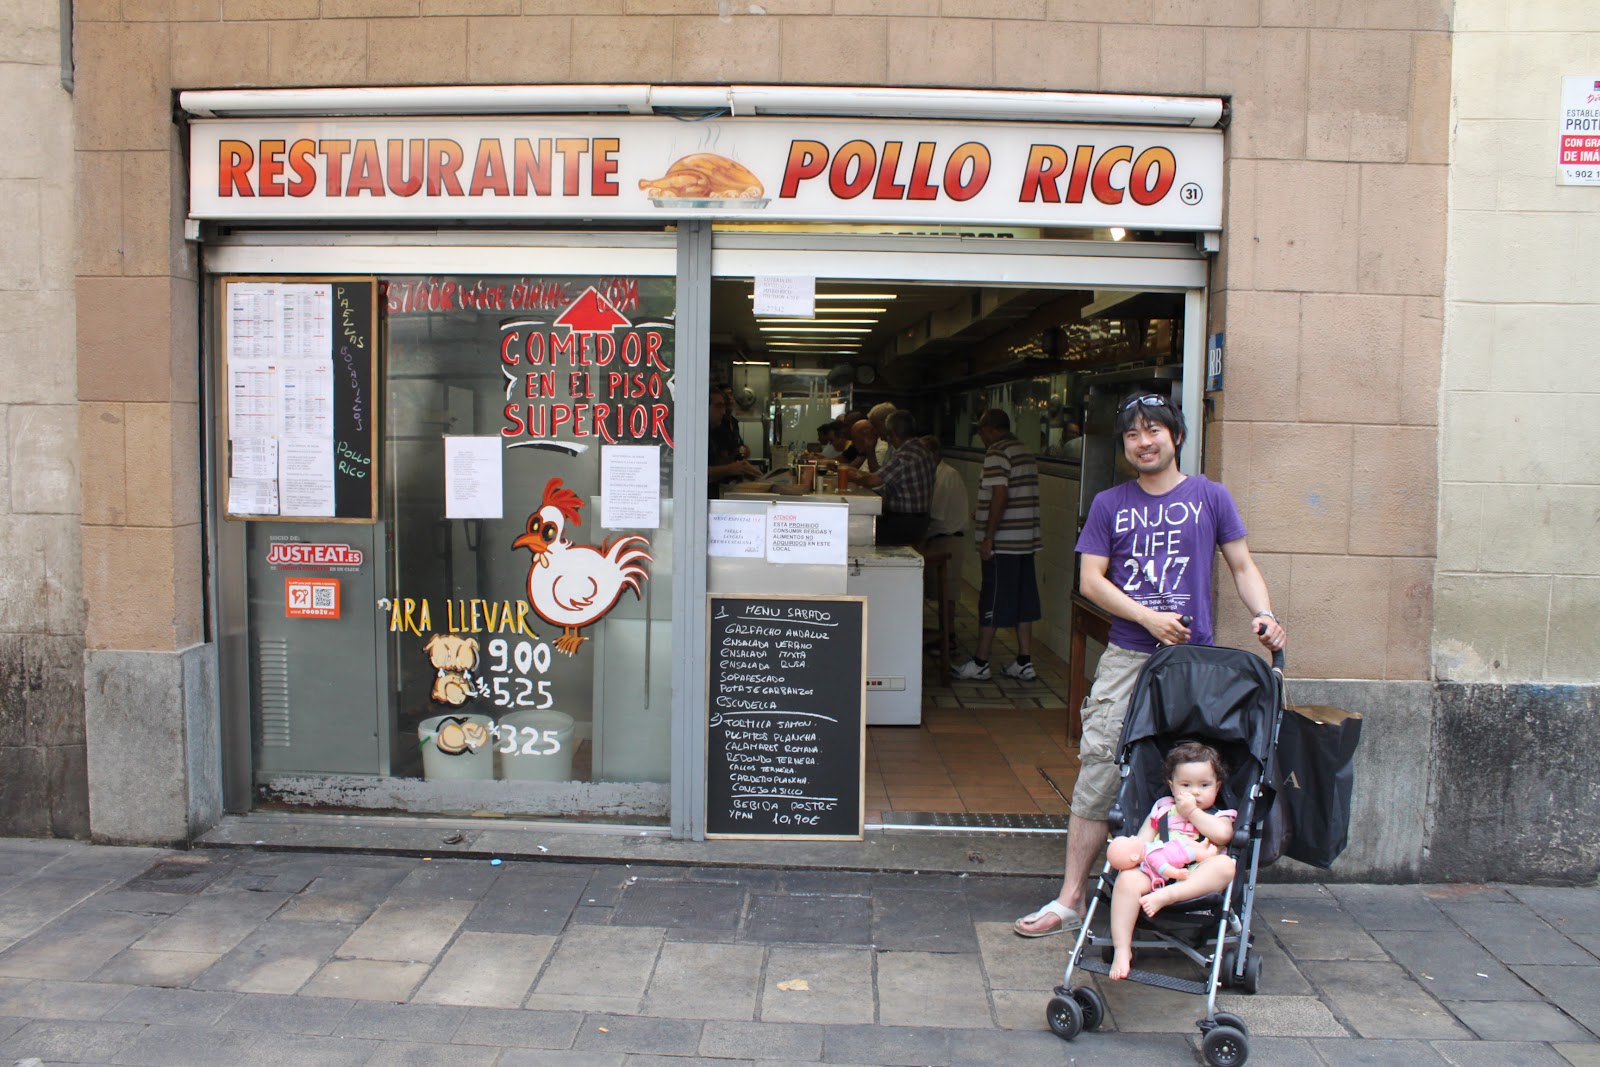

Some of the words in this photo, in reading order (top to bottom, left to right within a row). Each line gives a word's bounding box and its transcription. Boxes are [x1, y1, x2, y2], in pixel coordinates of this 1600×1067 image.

[1566, 109, 1600, 117] ESTABLE
[1564, 138, 1582, 147] CON
[1563, 150, 1577, 161] DE
[218, 137, 620, 198] RESTAURANTE
[778, 139, 991, 201] POLLO
[1018, 143, 1177, 206] RICO
[1185, 188, 1198, 200] 31
[1575, 170, 1592, 178] 902
[337, 287, 364, 348] PAELLAS
[501, 331, 670, 371] COMEDOR
[340, 346, 363, 431] BOCADILLOS
[526, 372, 555, 399] EN
[570, 372, 595, 399] EL
[609, 372, 663, 399] PISO
[501, 403, 675, 448] SUPERIOR
[337, 441, 371, 465] POLLO
[338, 461, 366, 478] RICO
[1115, 502, 1203, 533] ENJOY
[1131, 529, 1182, 557] LIFE
[270, 546, 312, 562] JUST
[1123, 556, 1190, 594] 24/7
[447, 599, 540, 640] LLEVAR
[745, 605, 781, 617] MENU
[787, 607, 831, 621] SABADO
[785, 628, 830, 640] ANDALUZ
[722, 637, 769, 649] ENSALADA
[775, 640, 813, 650] VERANO
[720, 648, 767, 659] ENSALADA
[778, 650, 807, 659] MIXTA
[719, 660, 770, 671] ENSALADA
[780, 660, 806, 669] RUSA
[493, 677, 554, 709] 5,25
[716, 695, 777, 710] ESCUDELLA
[499, 724, 561, 756] 3,25
[726, 752, 772, 764] REDONDO
[731, 783, 769, 794] CONEJO
[733, 800, 779, 811] BEBIDA
[790, 802, 838, 811] POSTRE
